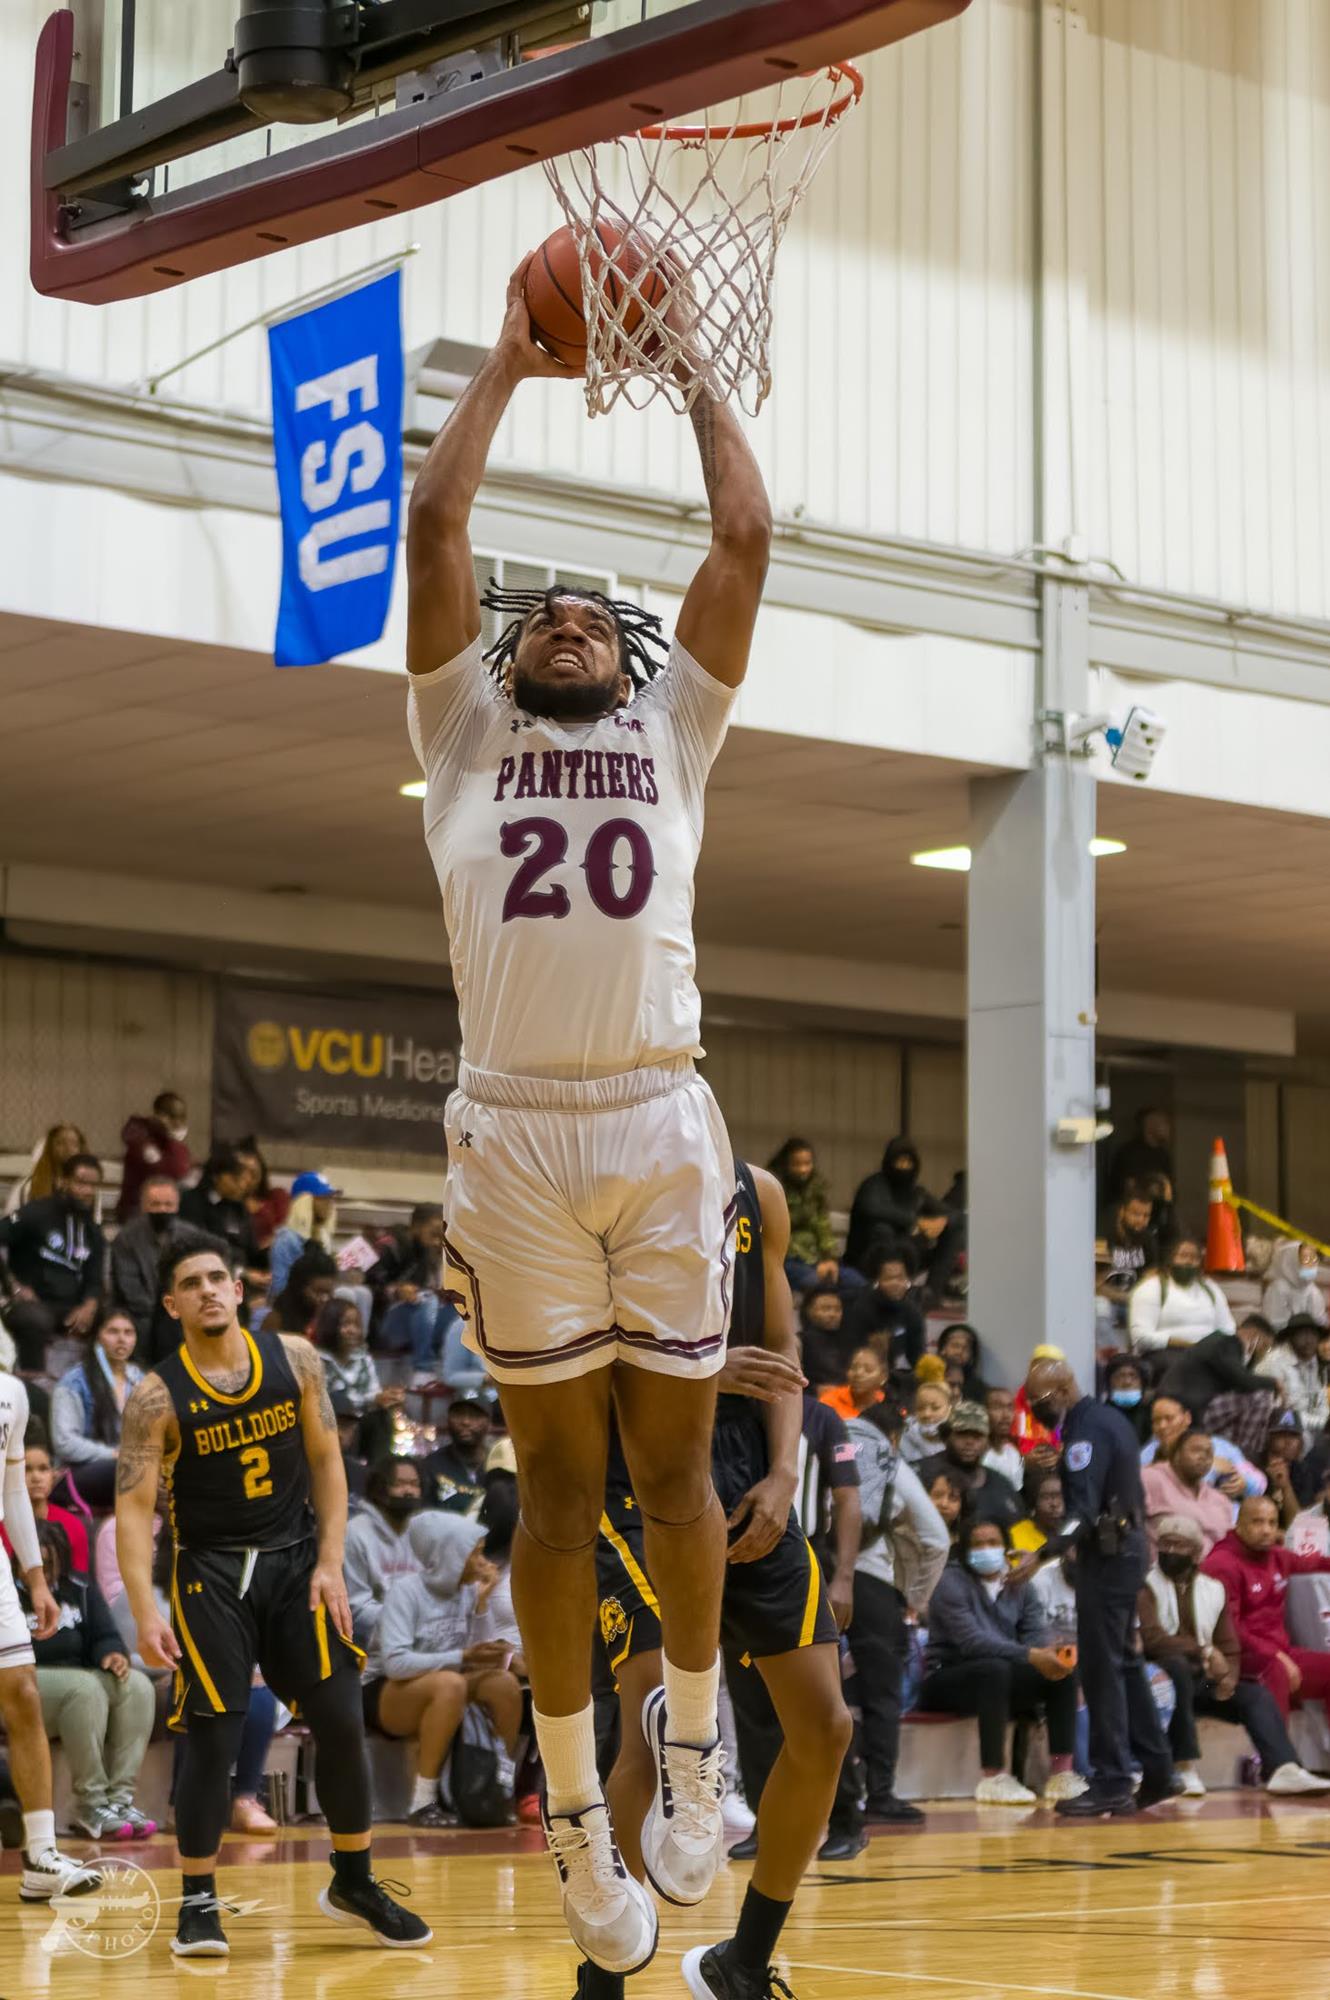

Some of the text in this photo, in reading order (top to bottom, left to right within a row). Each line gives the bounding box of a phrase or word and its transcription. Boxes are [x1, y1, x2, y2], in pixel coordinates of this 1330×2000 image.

[294, 353, 391, 592] FSU
[493, 749, 660, 806] PANTHERS
[499, 816, 659, 924] 20
[296, 1088, 358, 1118] Sports
[193, 1400, 297, 1456] BULLDOGS
[239, 1446, 273, 1500] 2
